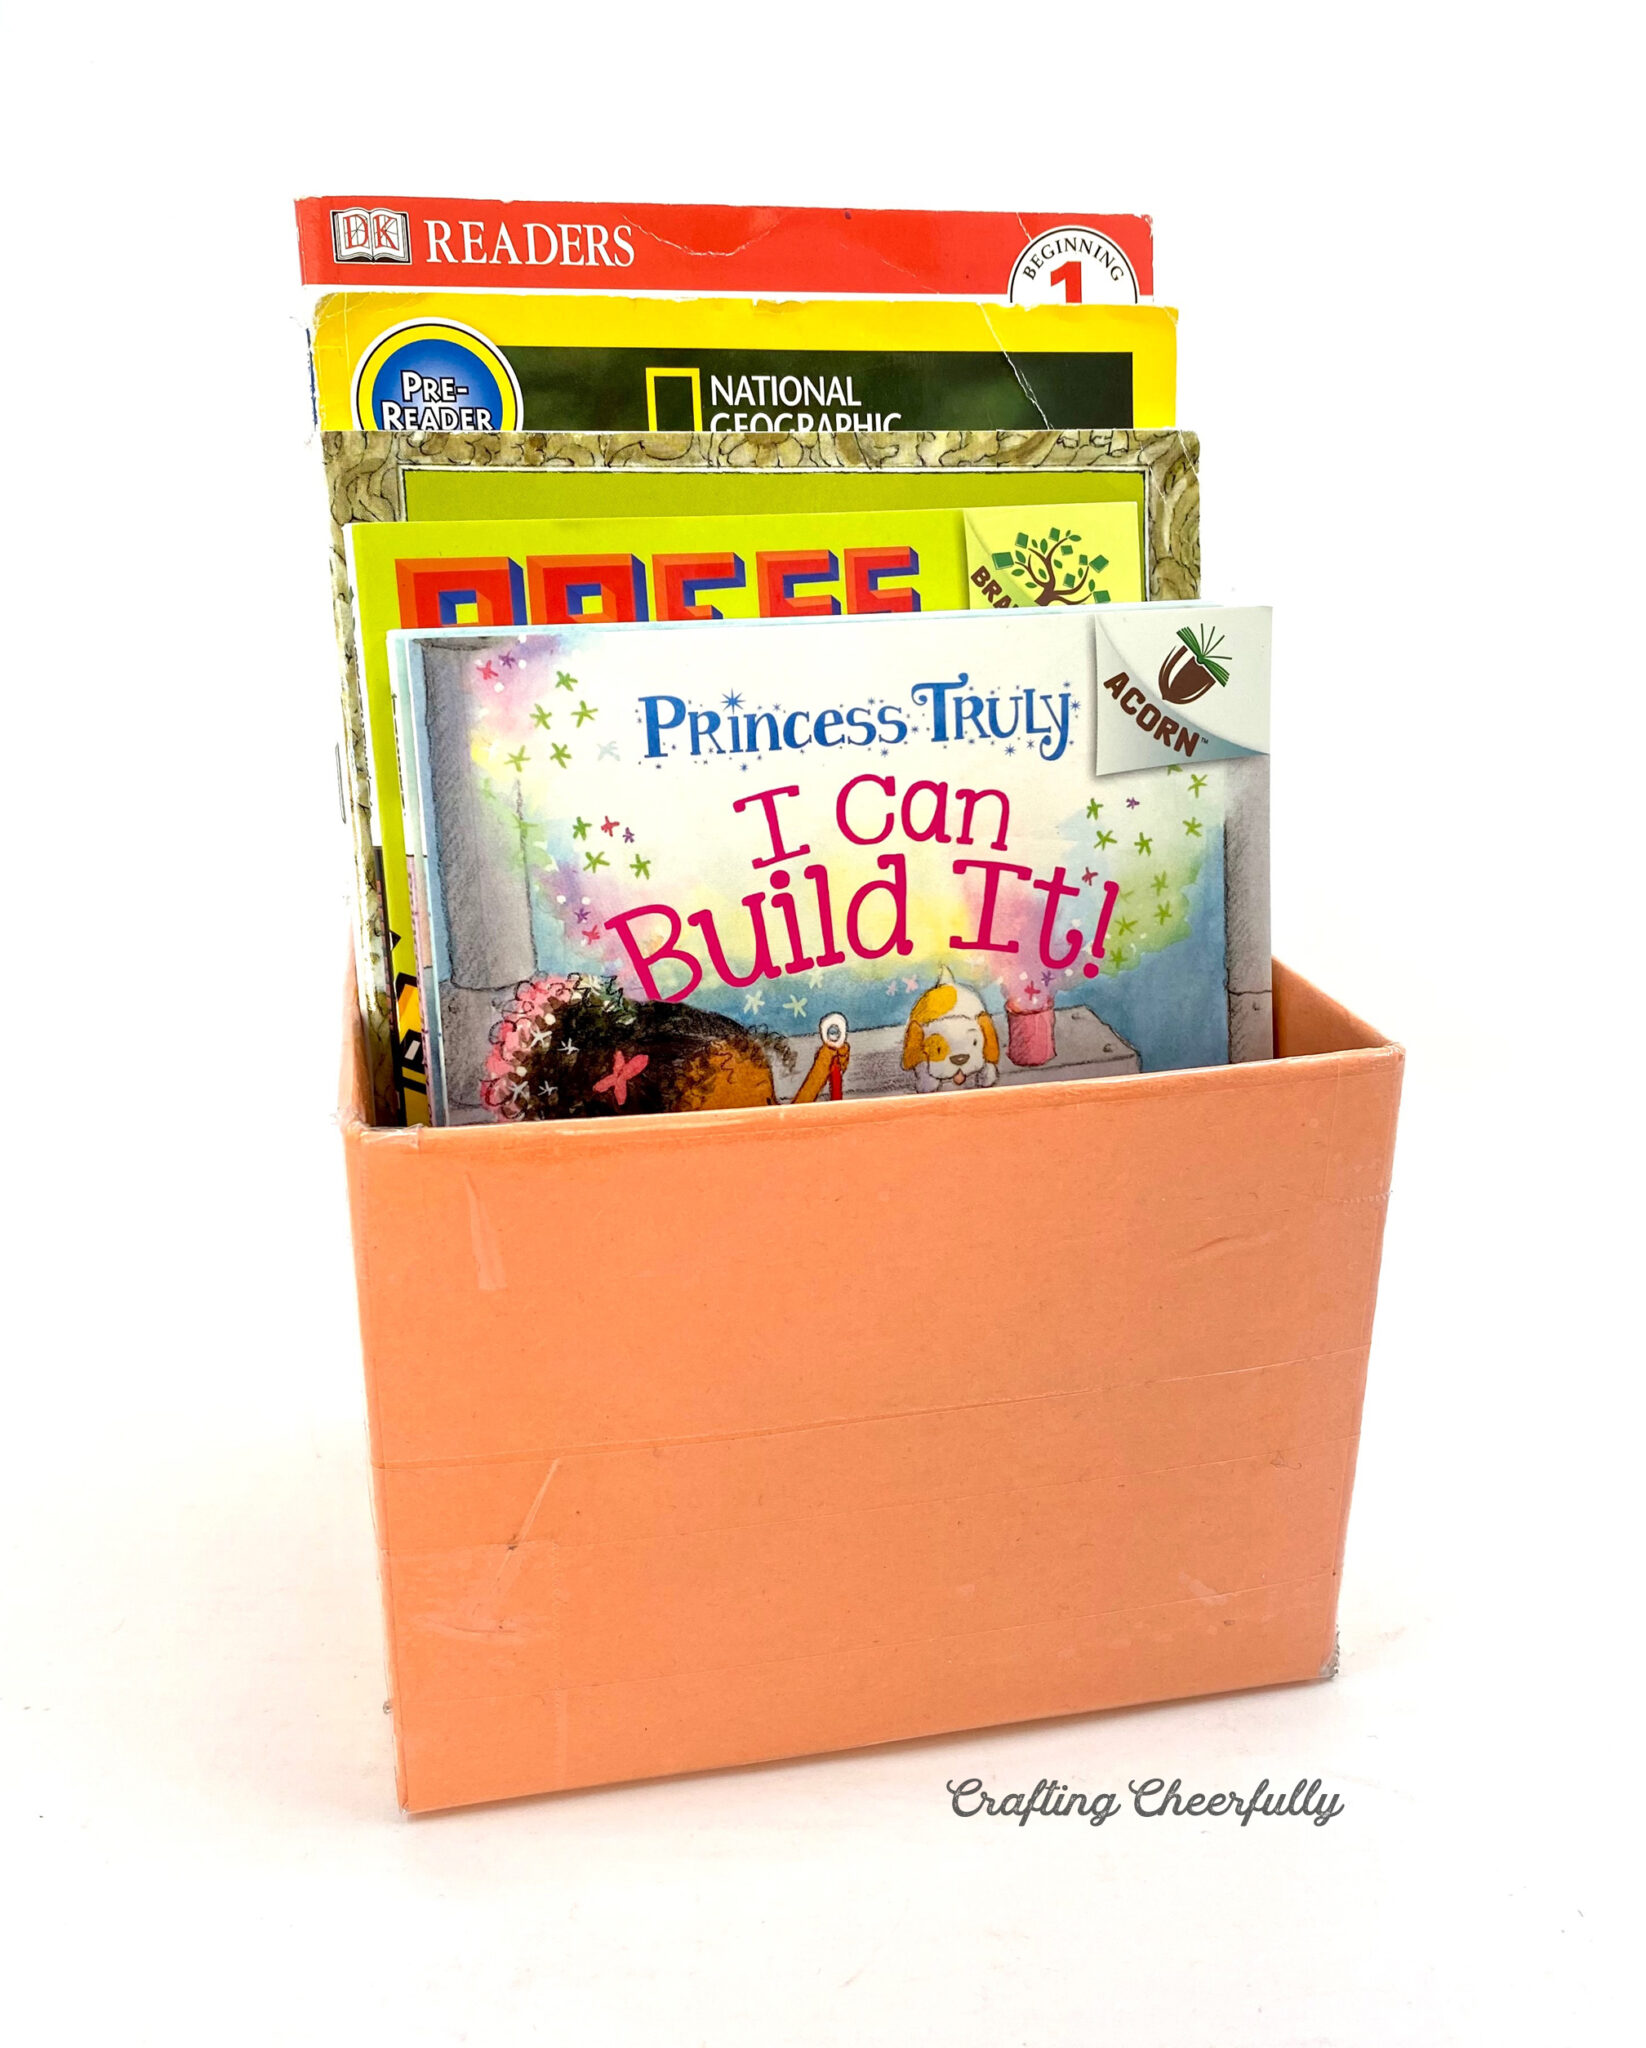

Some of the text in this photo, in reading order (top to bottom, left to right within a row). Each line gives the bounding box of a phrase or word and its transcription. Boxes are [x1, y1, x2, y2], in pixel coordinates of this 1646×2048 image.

[343, 213, 635, 267] DK READERS
[1023, 237, 1124, 281] BEGINNING
[1050, 261, 1082, 303] 1
[711, 375, 861, 407] NATIONAL
[733, 774, 1010, 869] I Can
[604, 853, 1120, 1003] Build It!
